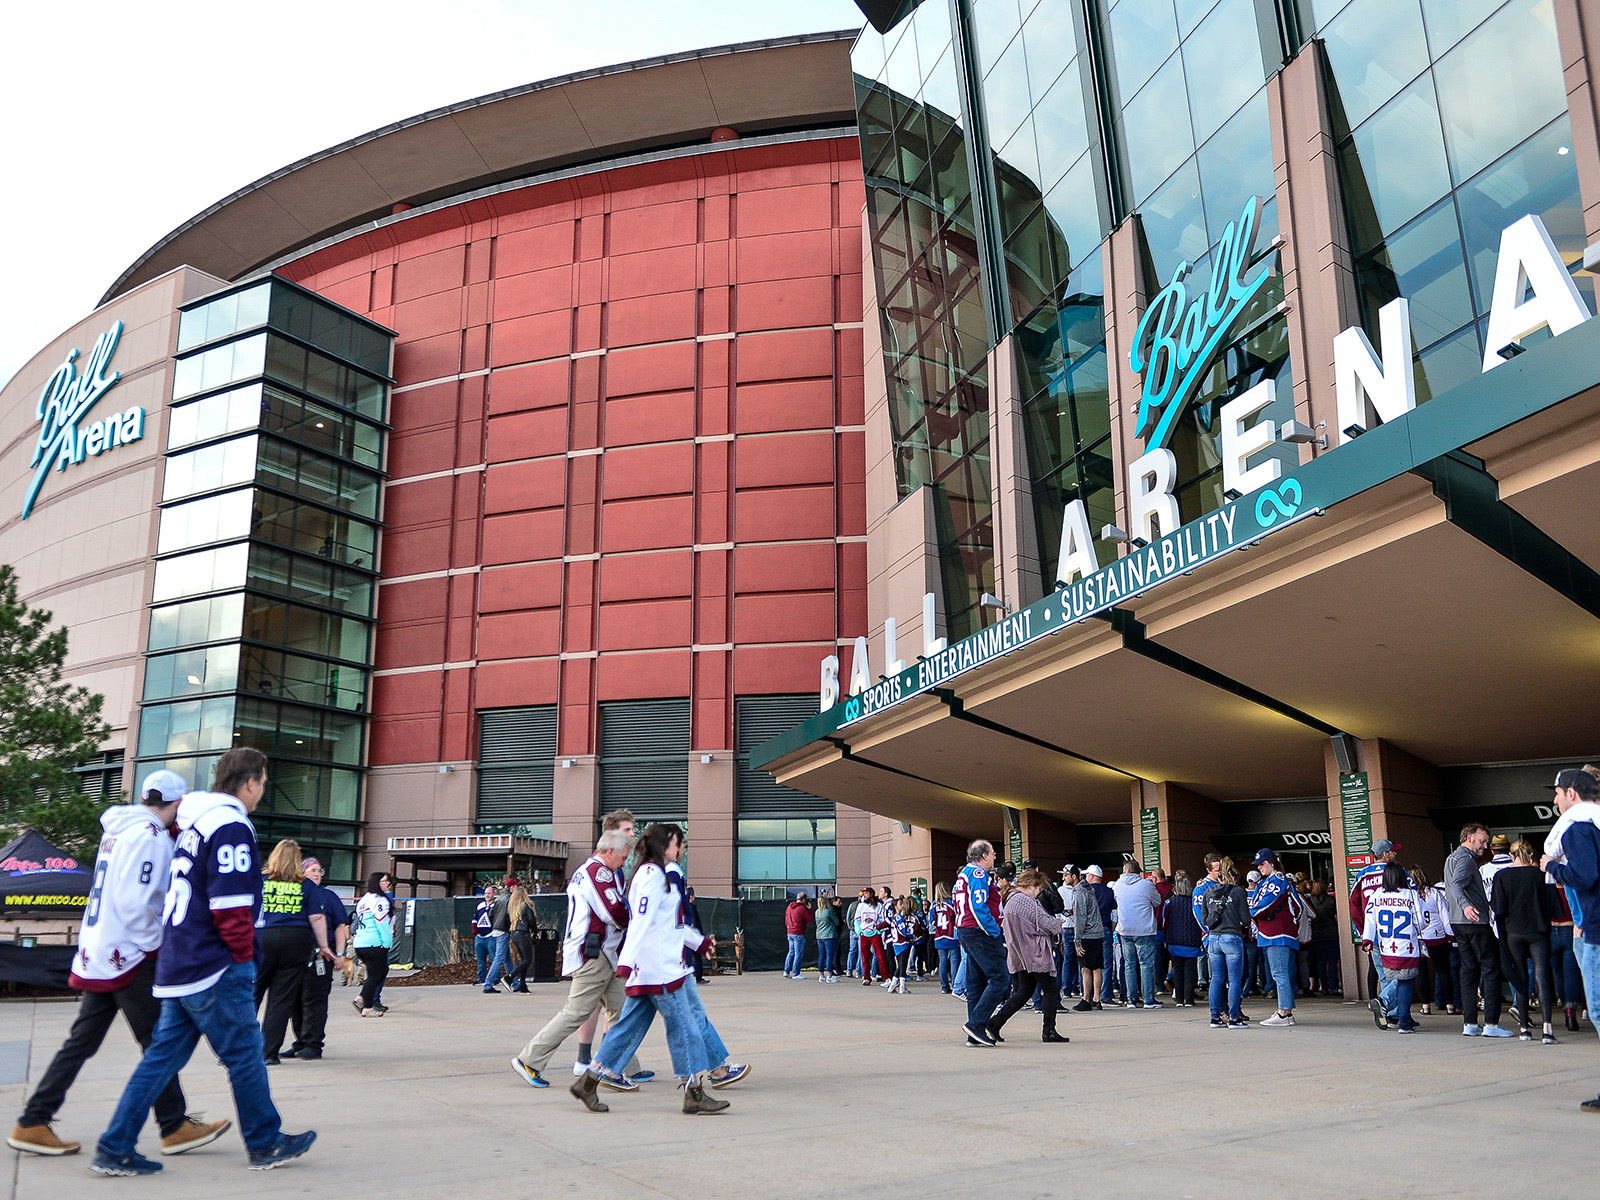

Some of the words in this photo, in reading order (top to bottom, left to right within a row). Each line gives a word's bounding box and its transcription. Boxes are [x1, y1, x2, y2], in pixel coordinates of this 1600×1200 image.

[1130, 195, 1276, 454] Ball
[23, 320, 124, 520] Ball
[56, 405, 144, 472] Arena
[820, 592, 948, 713] BALL
[1055, 213, 1592, 592] ARENA
[863, 675, 901, 715] SPORTS
[918, 608, 1033, 688] ENTERTAINMENT
[1060, 504, 1238, 622] SUSTAINABILITY
[45, 857, 78, 869] 100
[216, 843, 252, 874] 96
[139, 861, 153, 885] 8
[263, 894, 303, 905] EVENT
[1267, 883, 1281, 896] 92
[639, 896, 648, 915] 8
[1423, 911, 1431, 924] 9
[936, 912, 950, 930] 4
[1378, 909, 1412, 940] 92
